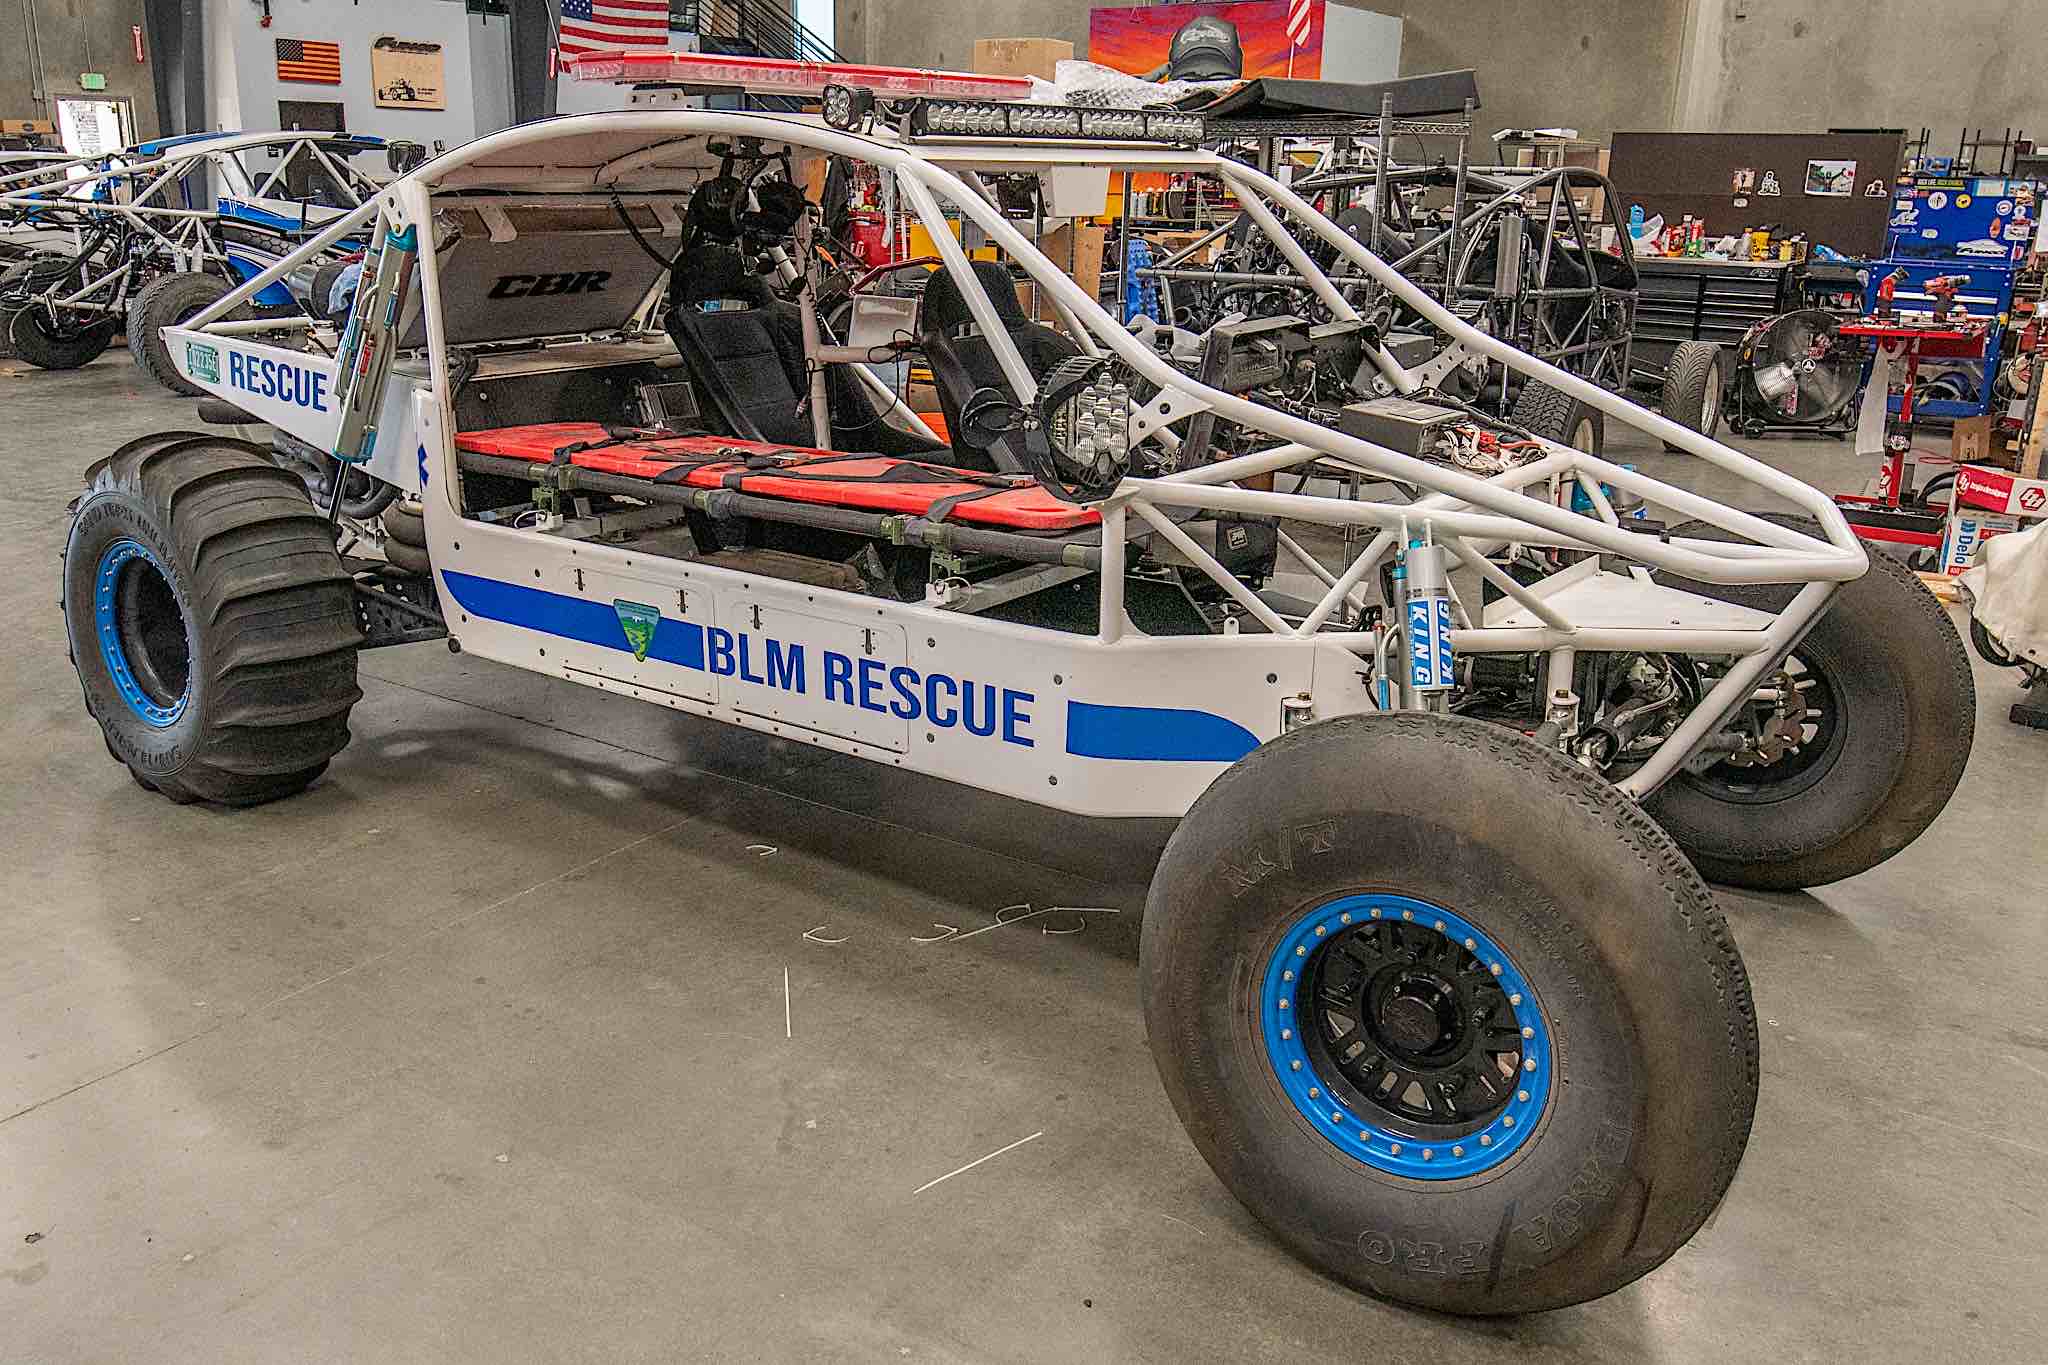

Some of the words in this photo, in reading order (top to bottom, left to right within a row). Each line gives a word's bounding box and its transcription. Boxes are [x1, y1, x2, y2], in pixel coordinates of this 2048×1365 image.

[488, 271, 612, 299] CBR
[229, 350, 328, 412] RESCUE
[1954, 535, 1974, 565] Delo
[1412, 604, 1431, 684] KING
[1438, 601, 1454, 680] KING
[706, 626, 806, 694] BLM
[823, 650, 1035, 748] RESCUE
